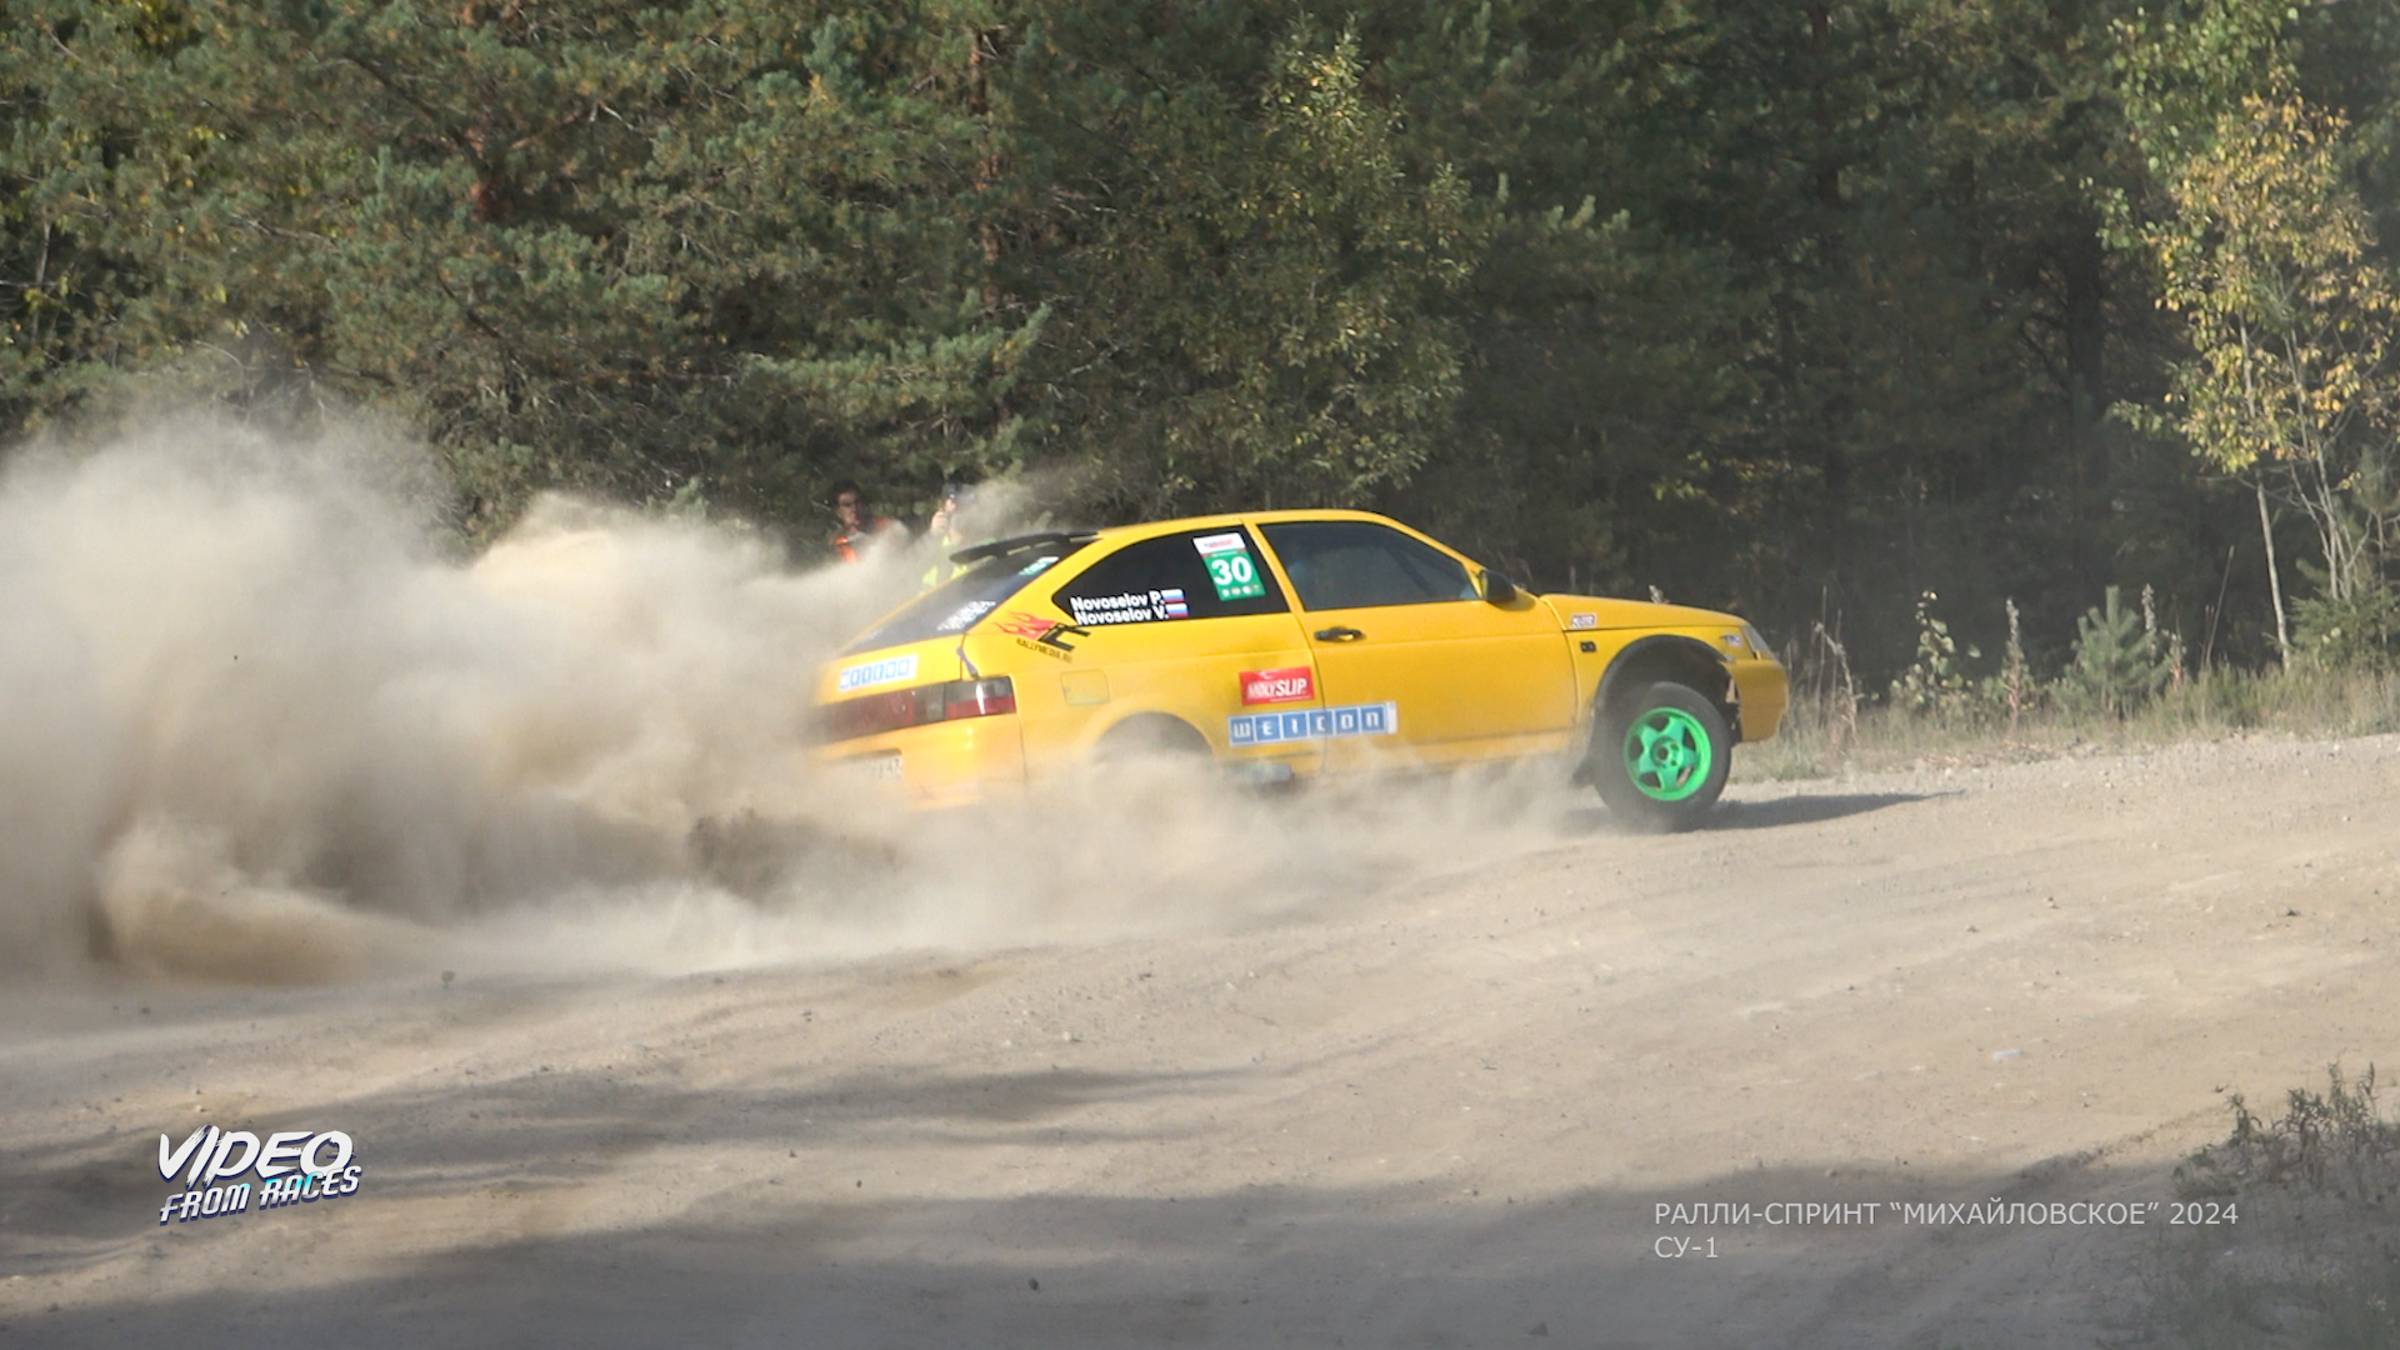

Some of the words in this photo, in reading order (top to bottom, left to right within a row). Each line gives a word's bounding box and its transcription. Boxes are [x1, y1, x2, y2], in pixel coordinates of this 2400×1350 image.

[1211, 556, 1252, 586] 30
[1070, 592, 1149, 612] Novoselov
[1075, 607, 1152, 625] Novoselov
[1153, 605, 1170, 620] V.
